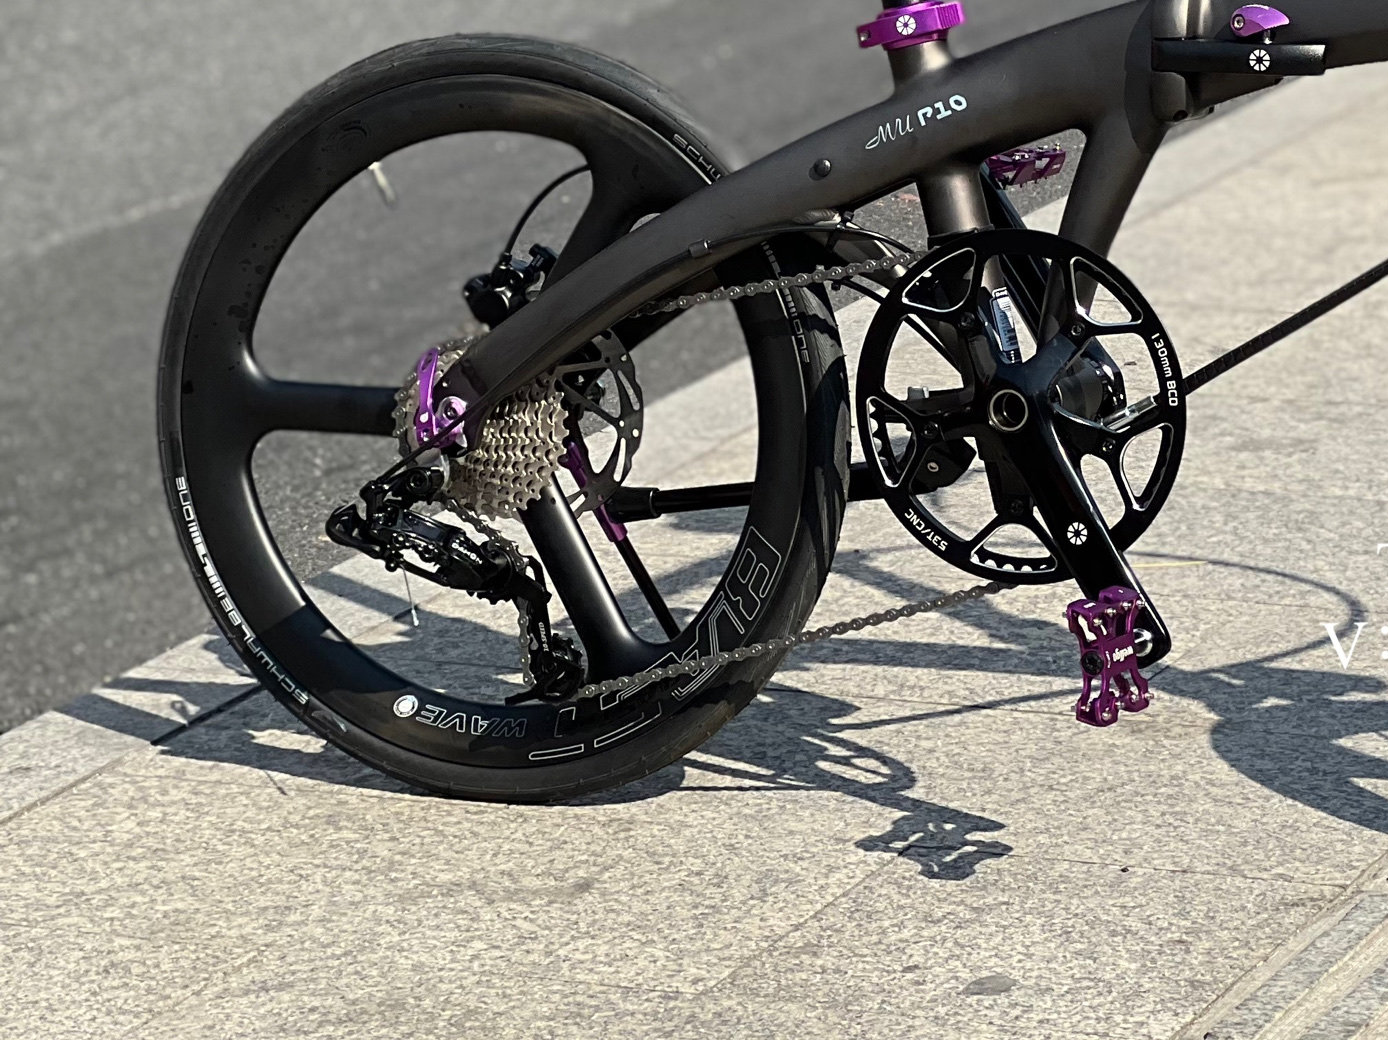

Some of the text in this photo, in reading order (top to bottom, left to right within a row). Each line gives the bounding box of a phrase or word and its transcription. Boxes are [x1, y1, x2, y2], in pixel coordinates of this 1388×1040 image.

[917, 94, 968, 127] P10
[1151, 332, 1179, 406] 130mm BCD
[904, 508, 949, 552] 53T/CNC
[220, 597, 310, 705] SCHWALBE
[415, 704, 527, 738] WAVE
